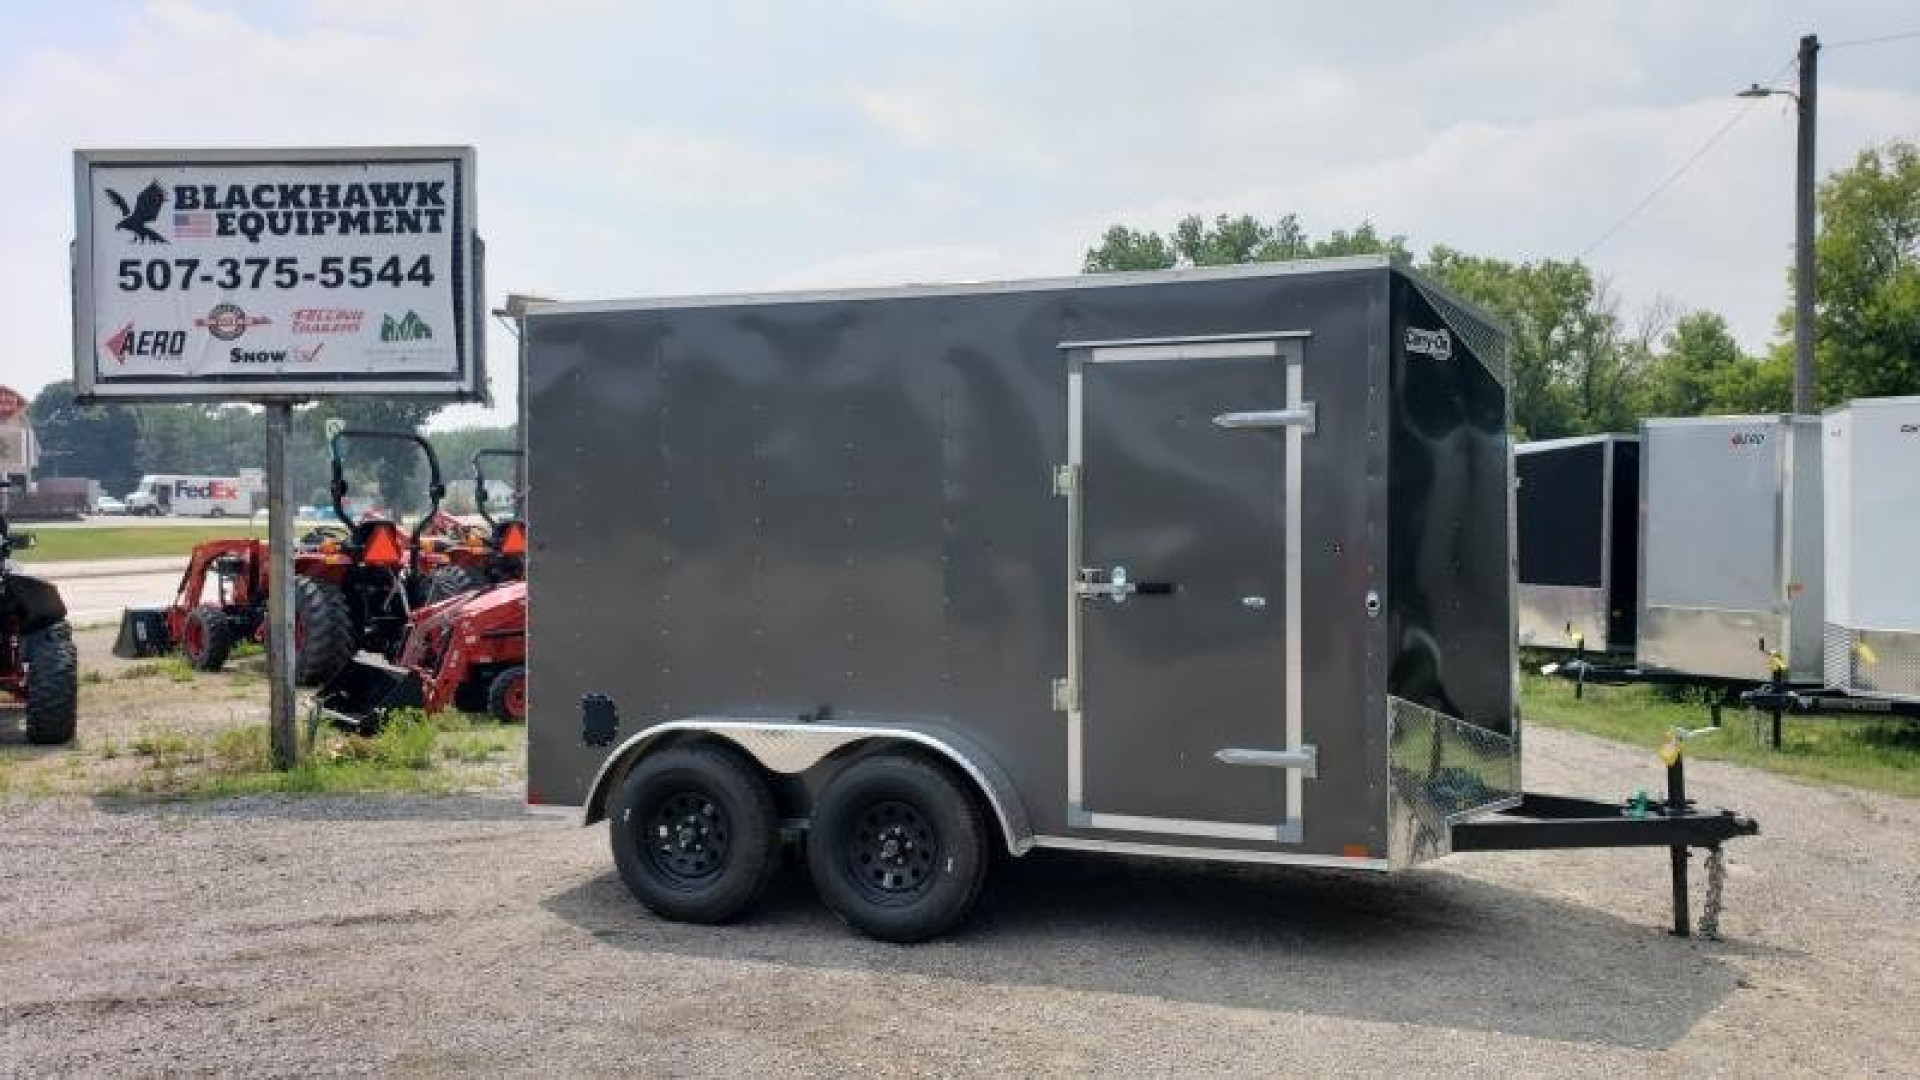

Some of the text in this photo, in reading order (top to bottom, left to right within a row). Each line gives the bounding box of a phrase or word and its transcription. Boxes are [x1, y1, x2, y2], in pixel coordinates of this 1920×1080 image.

[174, 181, 445, 210] BLACKHAWK
[215, 210, 445, 242] EQUIPMENT
[118, 254, 435, 291] 507-375-5544
[120, 330, 186, 356] AERO
[174, 479, 239, 500] FedEx
